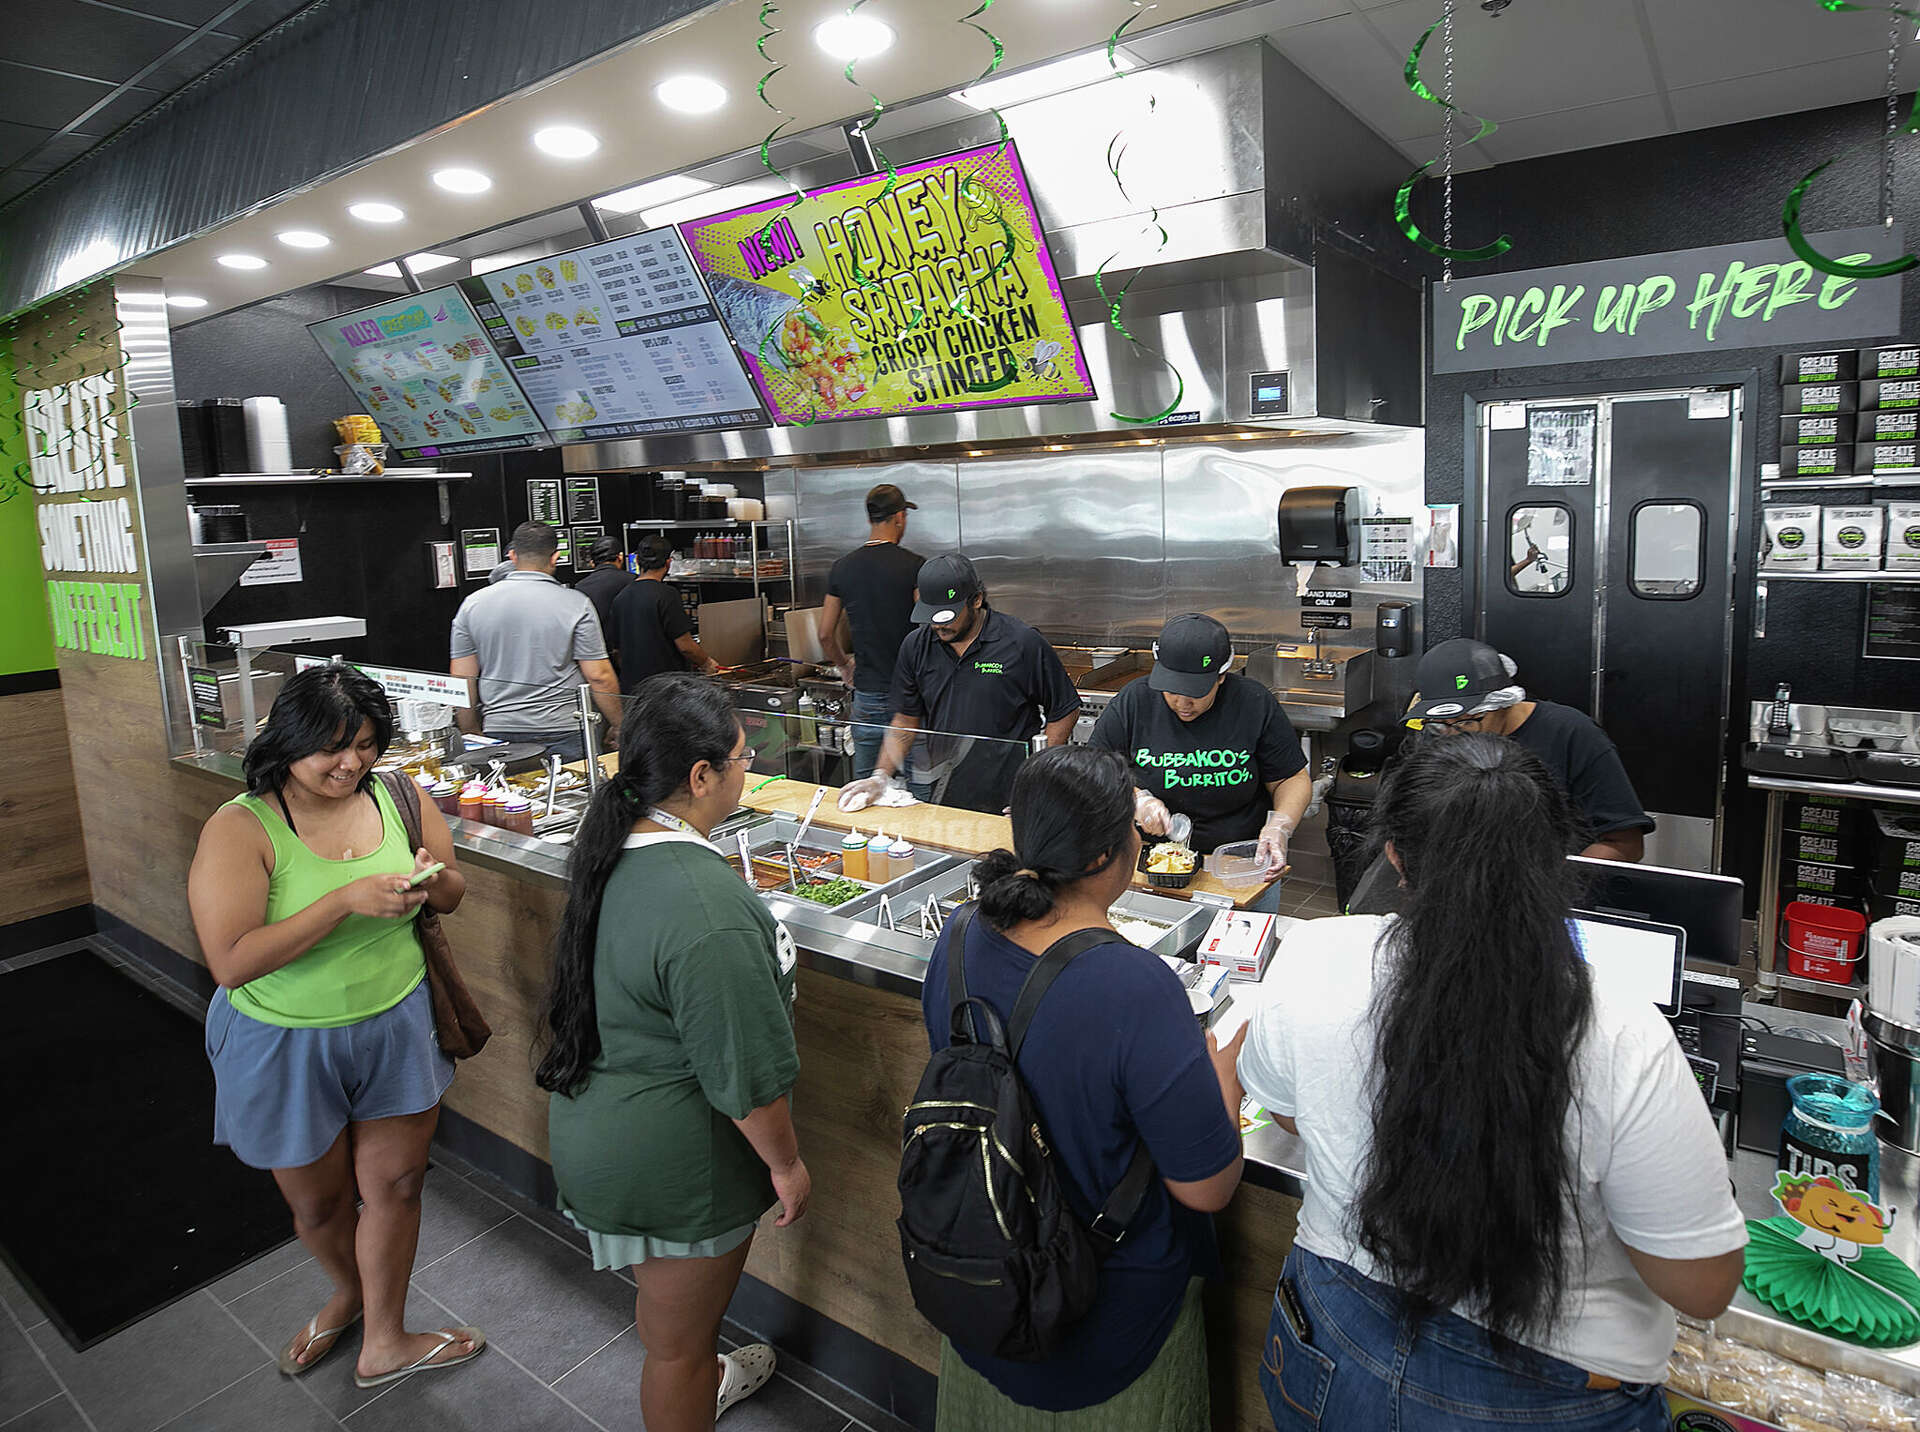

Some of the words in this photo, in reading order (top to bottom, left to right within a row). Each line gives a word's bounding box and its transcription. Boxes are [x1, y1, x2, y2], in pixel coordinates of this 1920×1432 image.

[814, 167, 966, 291] HONEY
[737, 217, 805, 280] NEW!
[841, 241, 1028, 343] SRIRACHA
[1456, 284, 1587, 351] PICK
[1592, 275, 1676, 336] UP
[1686, 253, 1872, 342] HERE
[871, 330, 940, 376] CRISPY
[944, 304, 1041, 359] CHICKEN
[1799, 355, 1839, 368] CREATE
[1879, 349, 1919, 362] CREATE
[907, 346, 1021, 403] STINGER
[1801, 386, 1840, 398] CREATE
[1880, 381, 1920, 394] CREATE
[1799, 418, 1838, 430] CREATE
[1876, 413, 1918, 425] CREATE
[1798, 448, 1837, 461] CREATE
[1874, 445, 1916, 458] CREATE
[1136, 748, 1250, 768] BUBBAKOO'S
[1801, 806, 1840, 820] CREATE
[1800, 836, 1838, 849] CREATE
[1797, 864, 1836, 880] CREATE
[1786, 1143, 1858, 1190] TIPS
